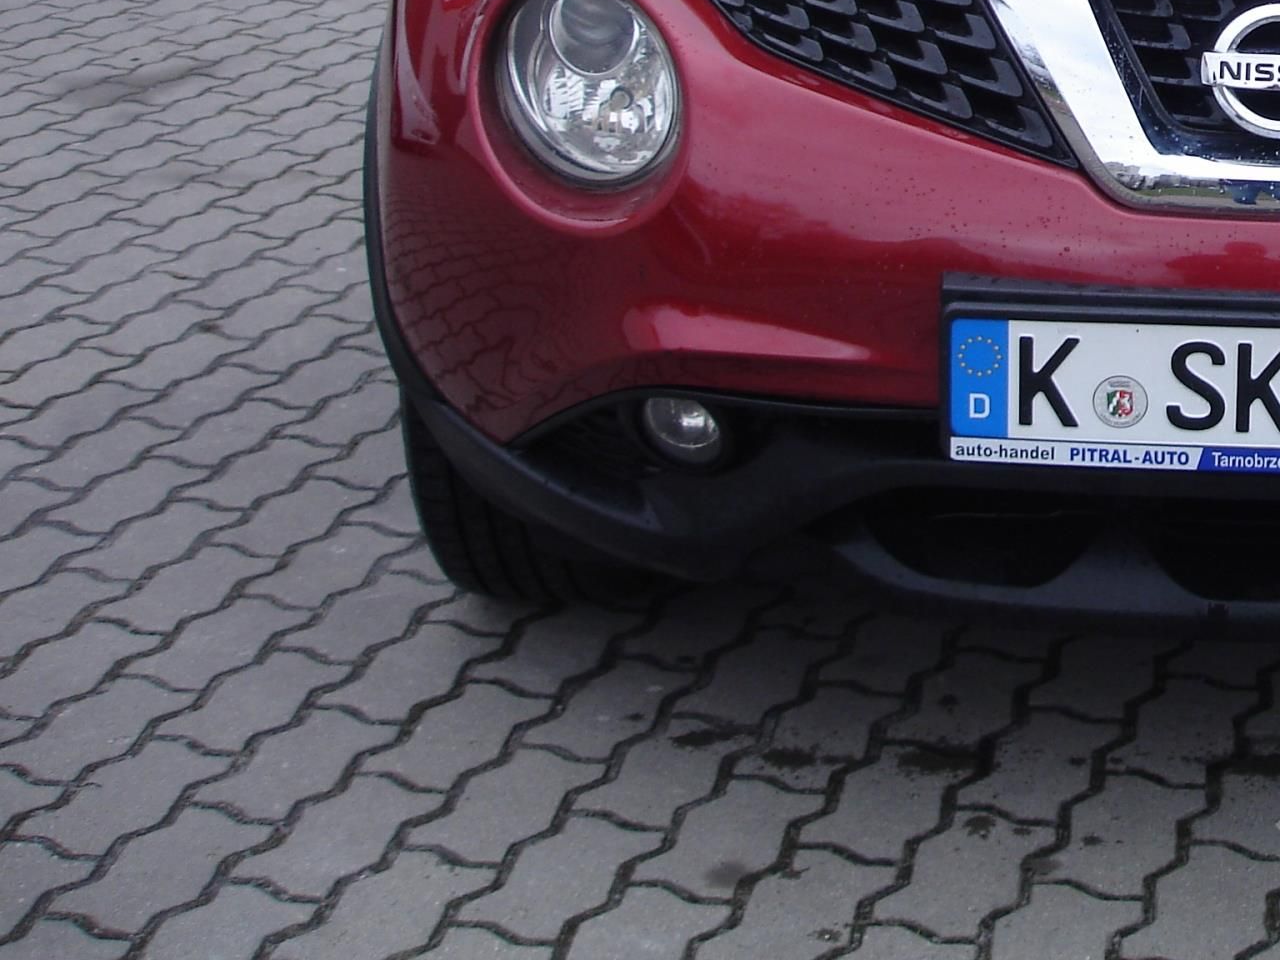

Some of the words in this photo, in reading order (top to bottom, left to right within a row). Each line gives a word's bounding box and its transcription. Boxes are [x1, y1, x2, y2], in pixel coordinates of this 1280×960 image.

[1018, 335, 1081, 428] K
[969, 392, 991, 418] D
[954, 444, 1056, 461] auto-handel
[1069, 447, 1190, 466] PITRAL-AUTO
